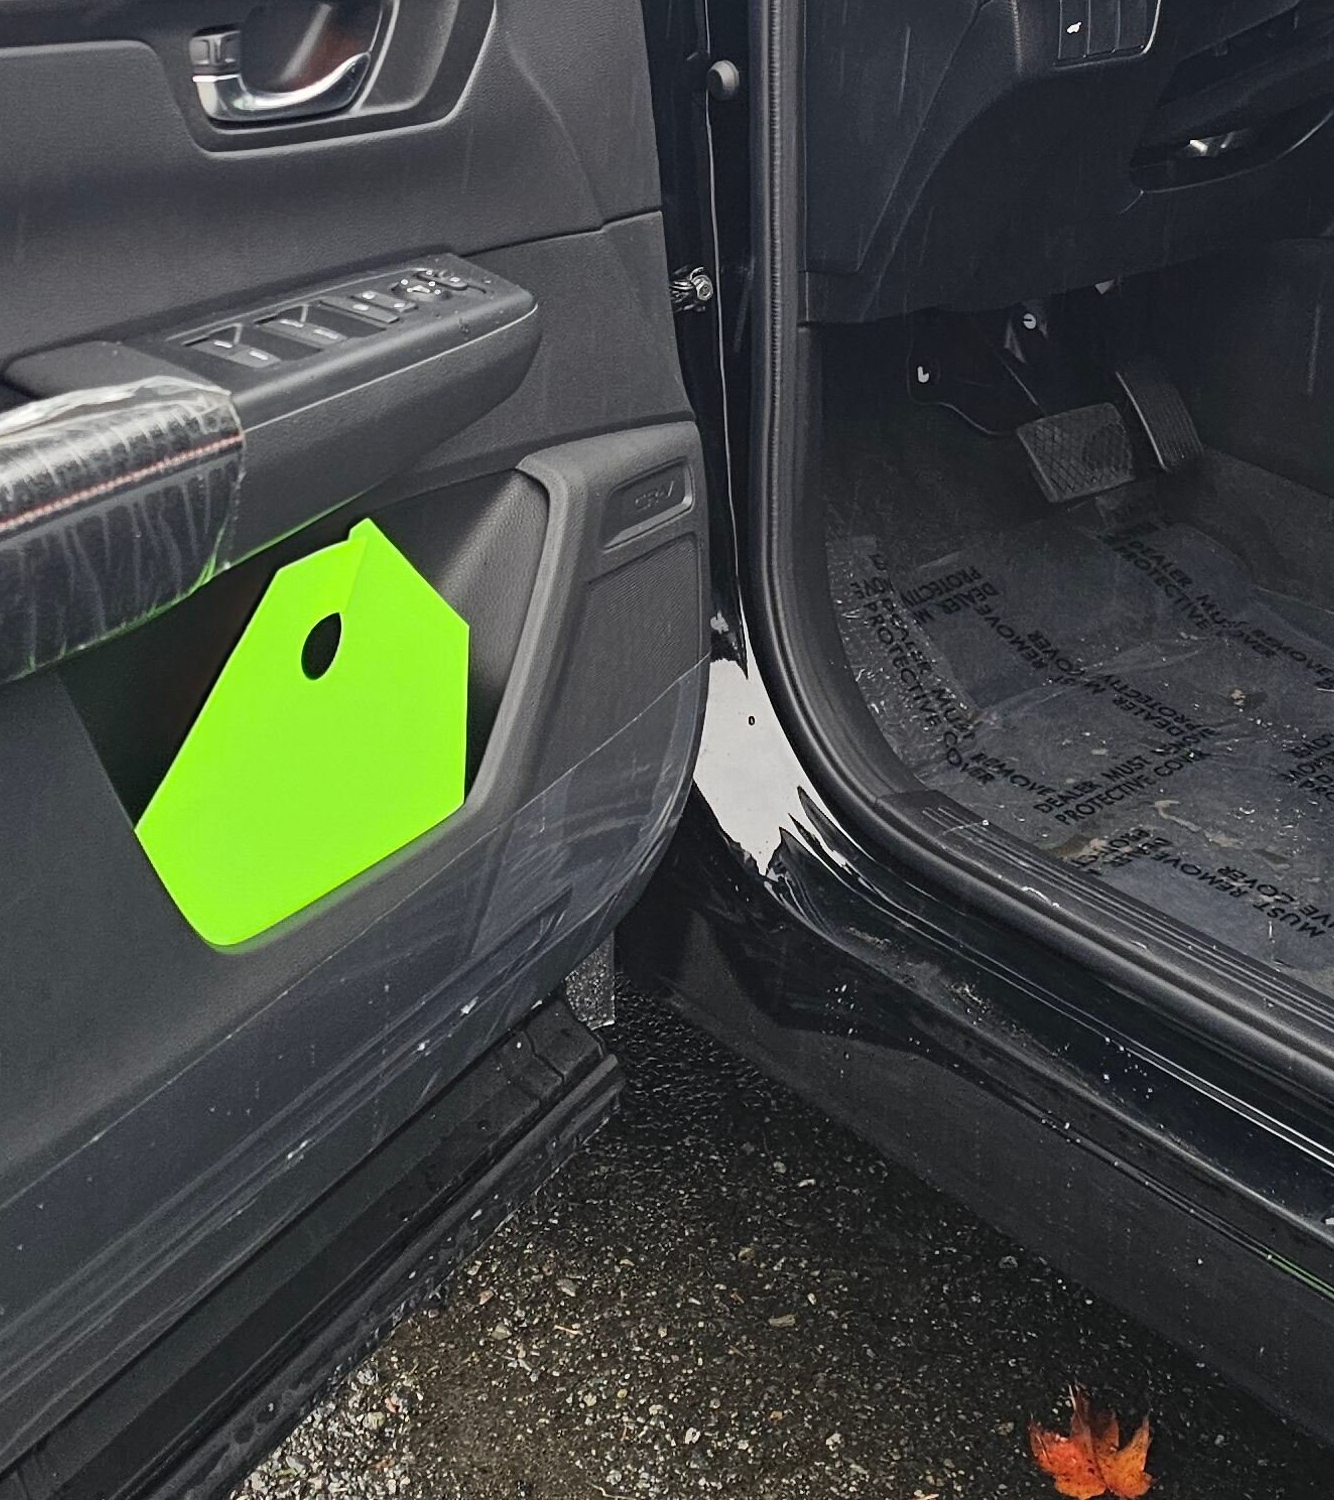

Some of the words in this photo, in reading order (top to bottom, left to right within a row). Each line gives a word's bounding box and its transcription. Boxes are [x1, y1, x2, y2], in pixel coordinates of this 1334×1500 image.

[1033, 779, 1103, 814] DEALER
[1101, 754, 1153, 783] MUST
[1054, 773, 1157, 826] PROTECTIVE
[1216, 864, 1295, 905] COVER
[1253, 900, 1326, 940] MUST
